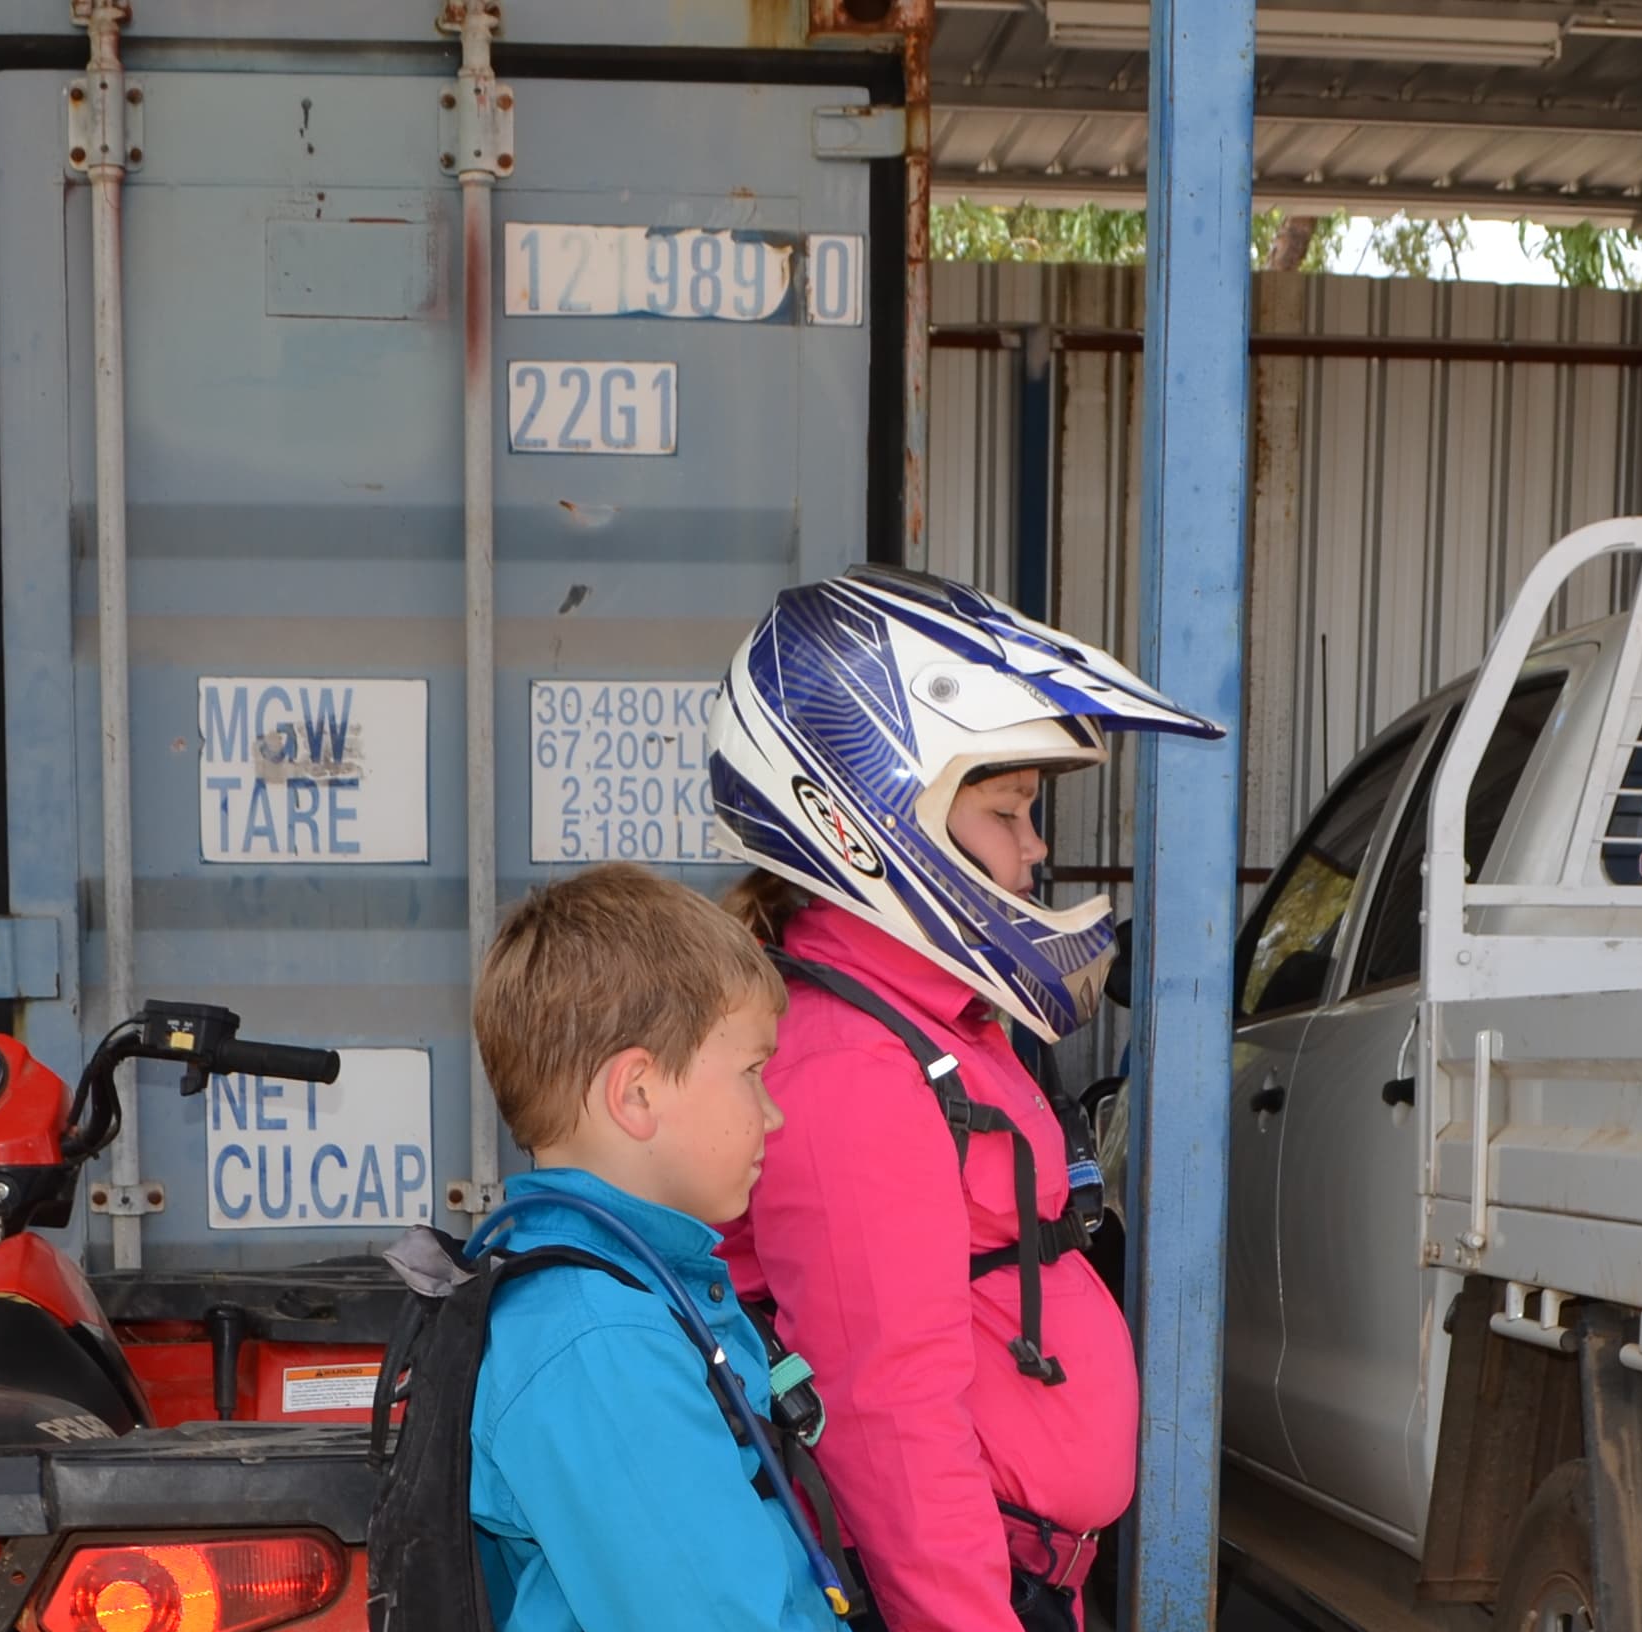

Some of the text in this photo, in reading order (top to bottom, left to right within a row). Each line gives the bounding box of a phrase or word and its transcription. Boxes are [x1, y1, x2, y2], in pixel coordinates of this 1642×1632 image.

[513, 366, 672, 450] 22G1
[204, 686, 353, 764] MGW
[536, 686, 664, 729] 30,480
[536, 729, 710, 772] 67,200 L
[206, 776, 361, 854] TARE
[561, 775, 664, 820] 2,350
[560, 819, 664, 861] 5,180
[213, 1144, 428, 1220] CU.CAP.
